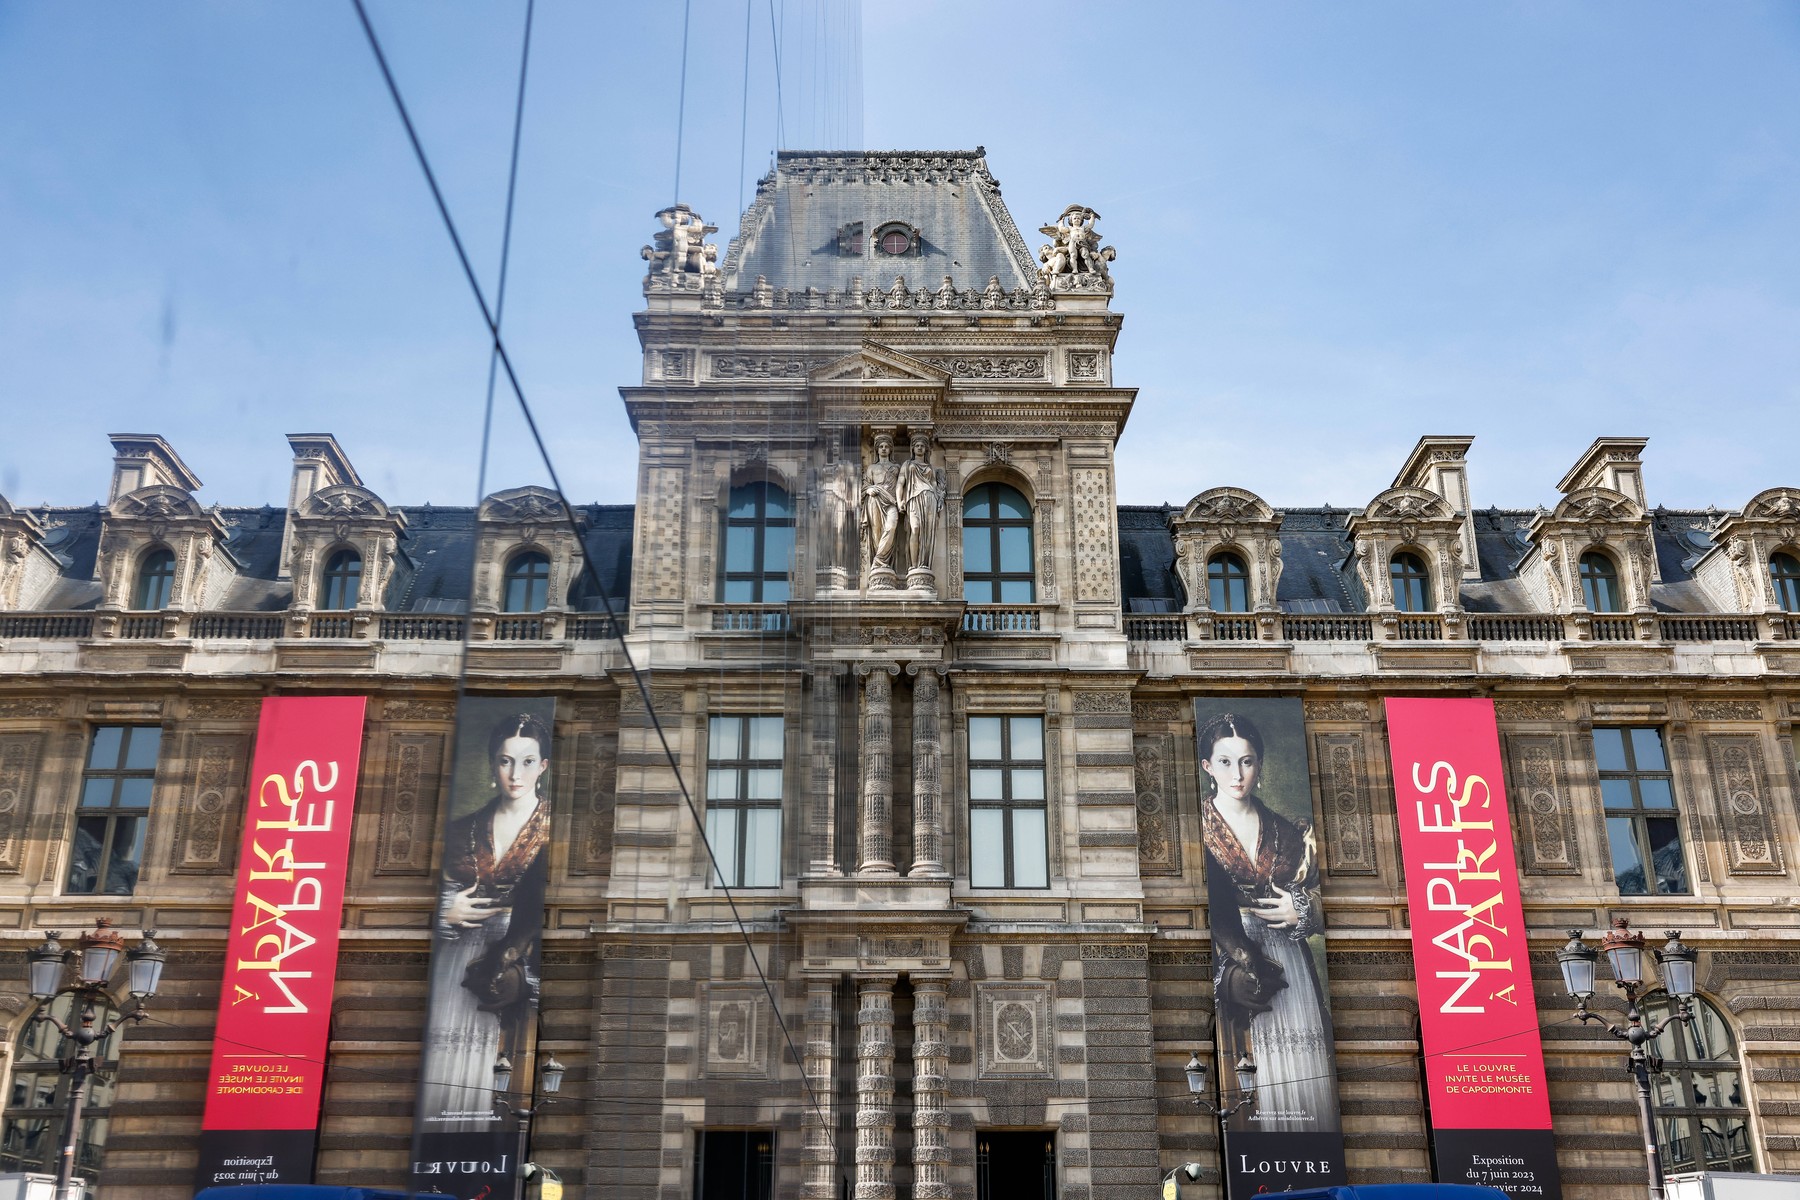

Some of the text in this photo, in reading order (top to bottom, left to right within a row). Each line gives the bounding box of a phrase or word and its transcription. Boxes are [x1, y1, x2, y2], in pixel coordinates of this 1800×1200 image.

[1412, 760, 1485, 1014] NAPLES
[1447, 774, 1518, 1006] À PARIS
[1457, 1064, 1517, 1072] LE LOUVRE
[1445, 1073, 1531, 1083] INVITE LE MUSÉE
[1446, 1085, 1533, 1094] DE CAPODIMONTE
[1472, 1154, 1525, 1168] Exposition
[1466, 1168, 1535, 1182] du 7 juin 2023
[1520, 1185, 1543, 1196] 2024
